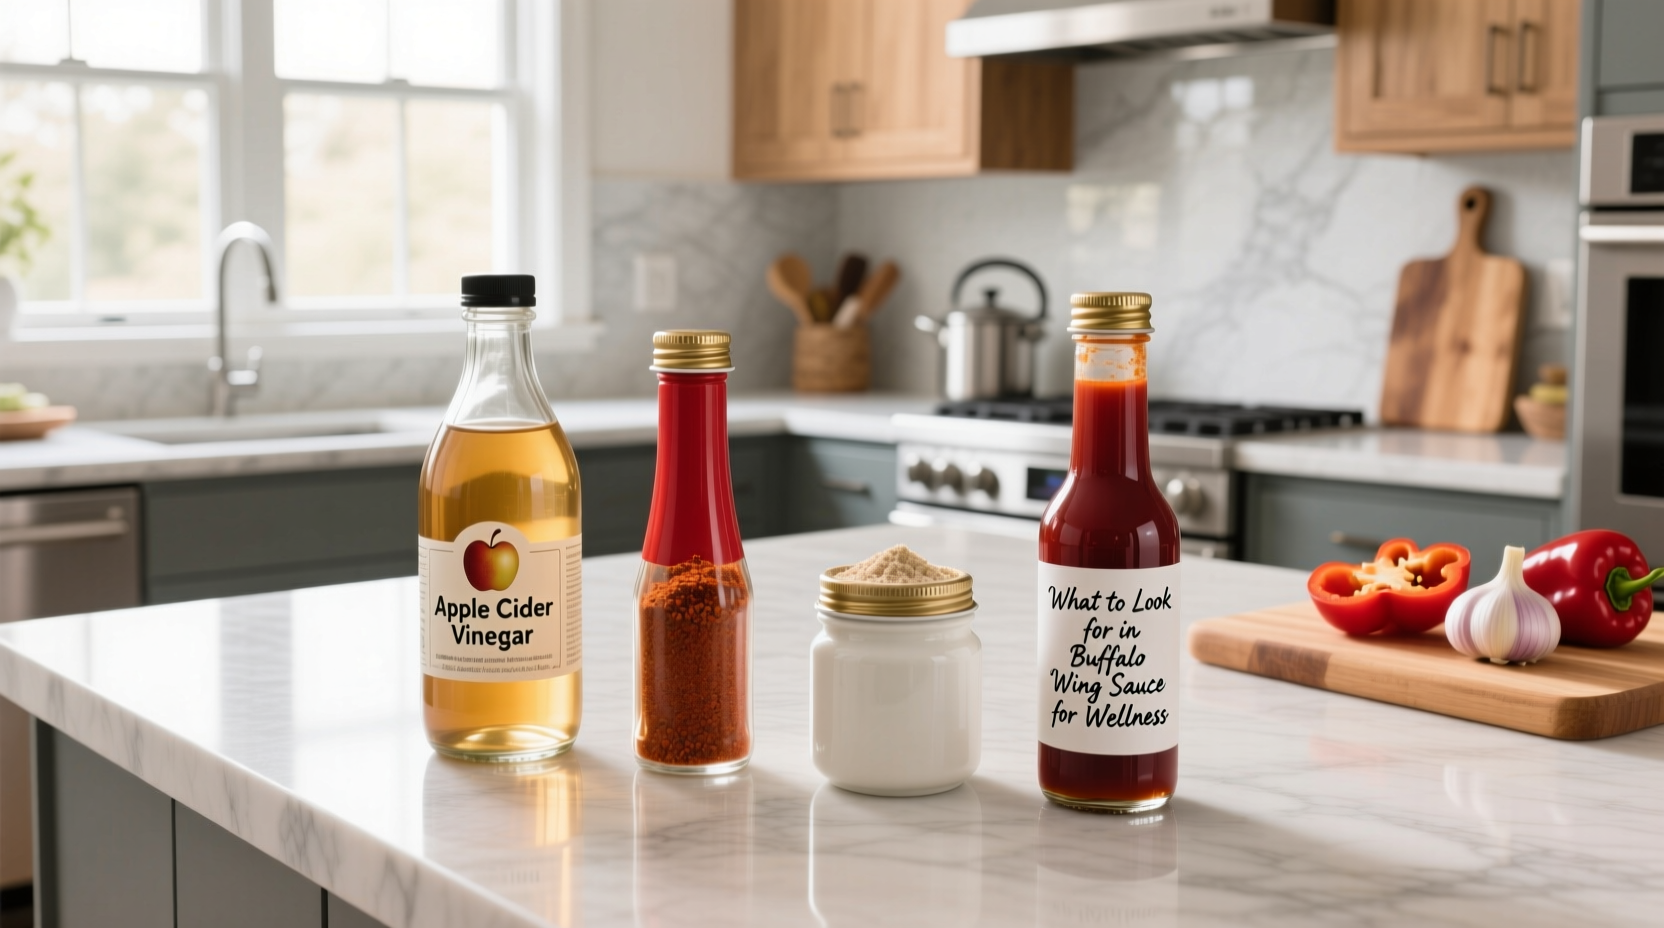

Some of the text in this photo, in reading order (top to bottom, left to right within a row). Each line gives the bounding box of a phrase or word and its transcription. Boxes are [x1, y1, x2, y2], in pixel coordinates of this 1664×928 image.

[434, 595, 554, 623] Apple Cider
[1048, 585, 1171, 613] What to Look
[451, 624, 534, 651] Vinegar
[1083, 616, 1141, 644] for in
[1070, 644, 1146, 676] Buffalo
[1050, 668, 1166, 704] Wing Sauce
[1051, 699, 1169, 728] for Wellness
